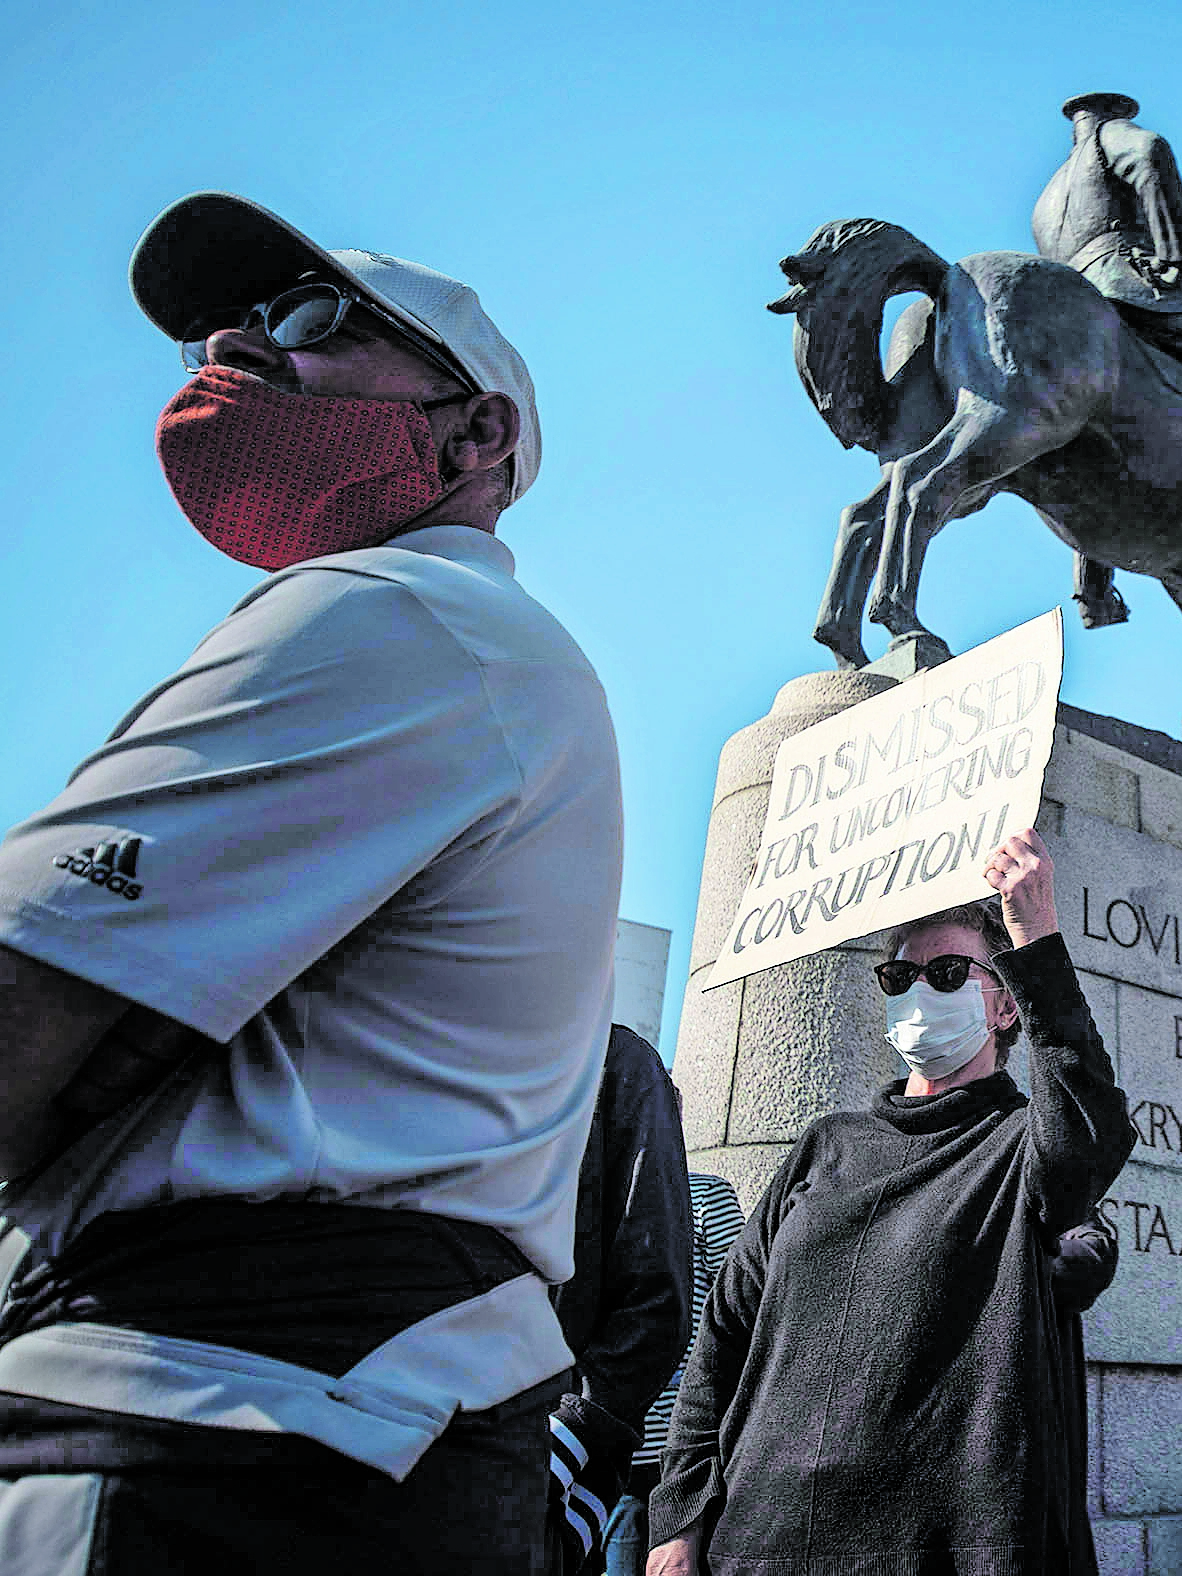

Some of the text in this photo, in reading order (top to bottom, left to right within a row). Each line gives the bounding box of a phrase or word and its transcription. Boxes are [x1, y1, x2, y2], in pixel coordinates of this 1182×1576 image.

[755, 727, 1034, 889] FOR UNCOVERING
[778, 661, 1047, 822] DISMISSED
[52, 850, 144, 901] adidas
